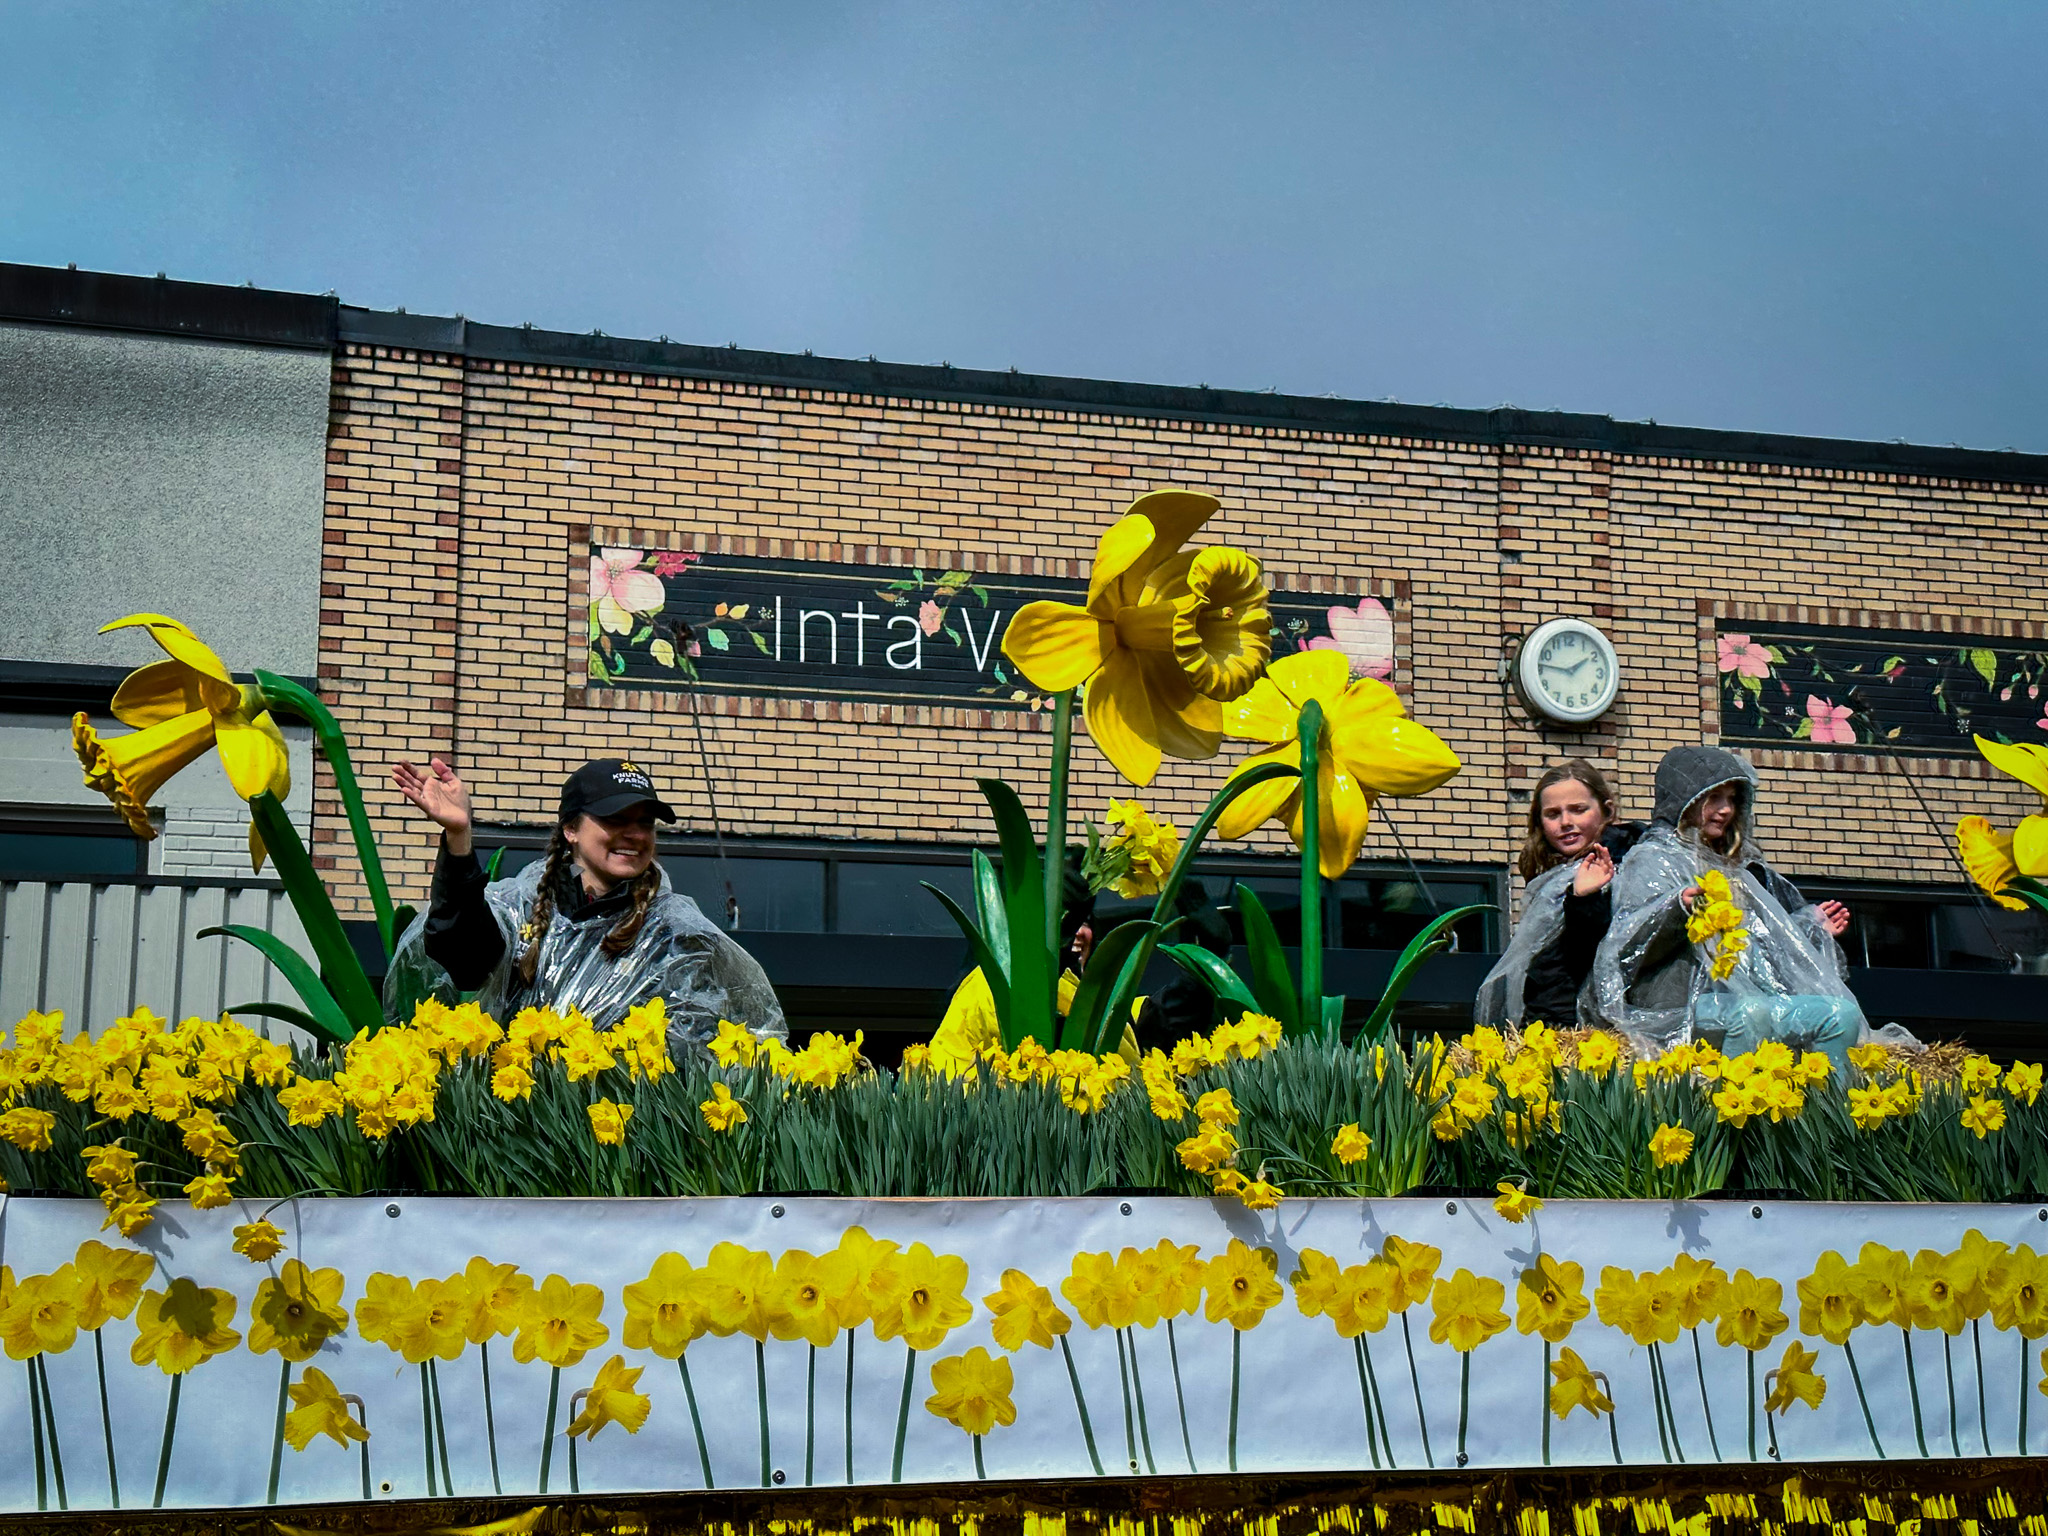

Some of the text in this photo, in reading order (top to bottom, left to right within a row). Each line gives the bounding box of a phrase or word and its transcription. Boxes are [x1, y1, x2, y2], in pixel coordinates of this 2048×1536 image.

[774, 595, 923, 671] Inta
[1552, 639, 1561, 650] 11
[1563, 635, 1575, 647] 12
[1581, 640, 1586, 652] 1
[1590, 651, 1598, 663] 2
[1596, 667, 1604, 680] 3
[1541, 679, 1549, 691] 8
[1590, 683, 1598, 695] 4
[1553, 691, 1561, 703] 7
[1566, 696, 1575, 708] 6
[1580, 693, 1588, 706] 5
